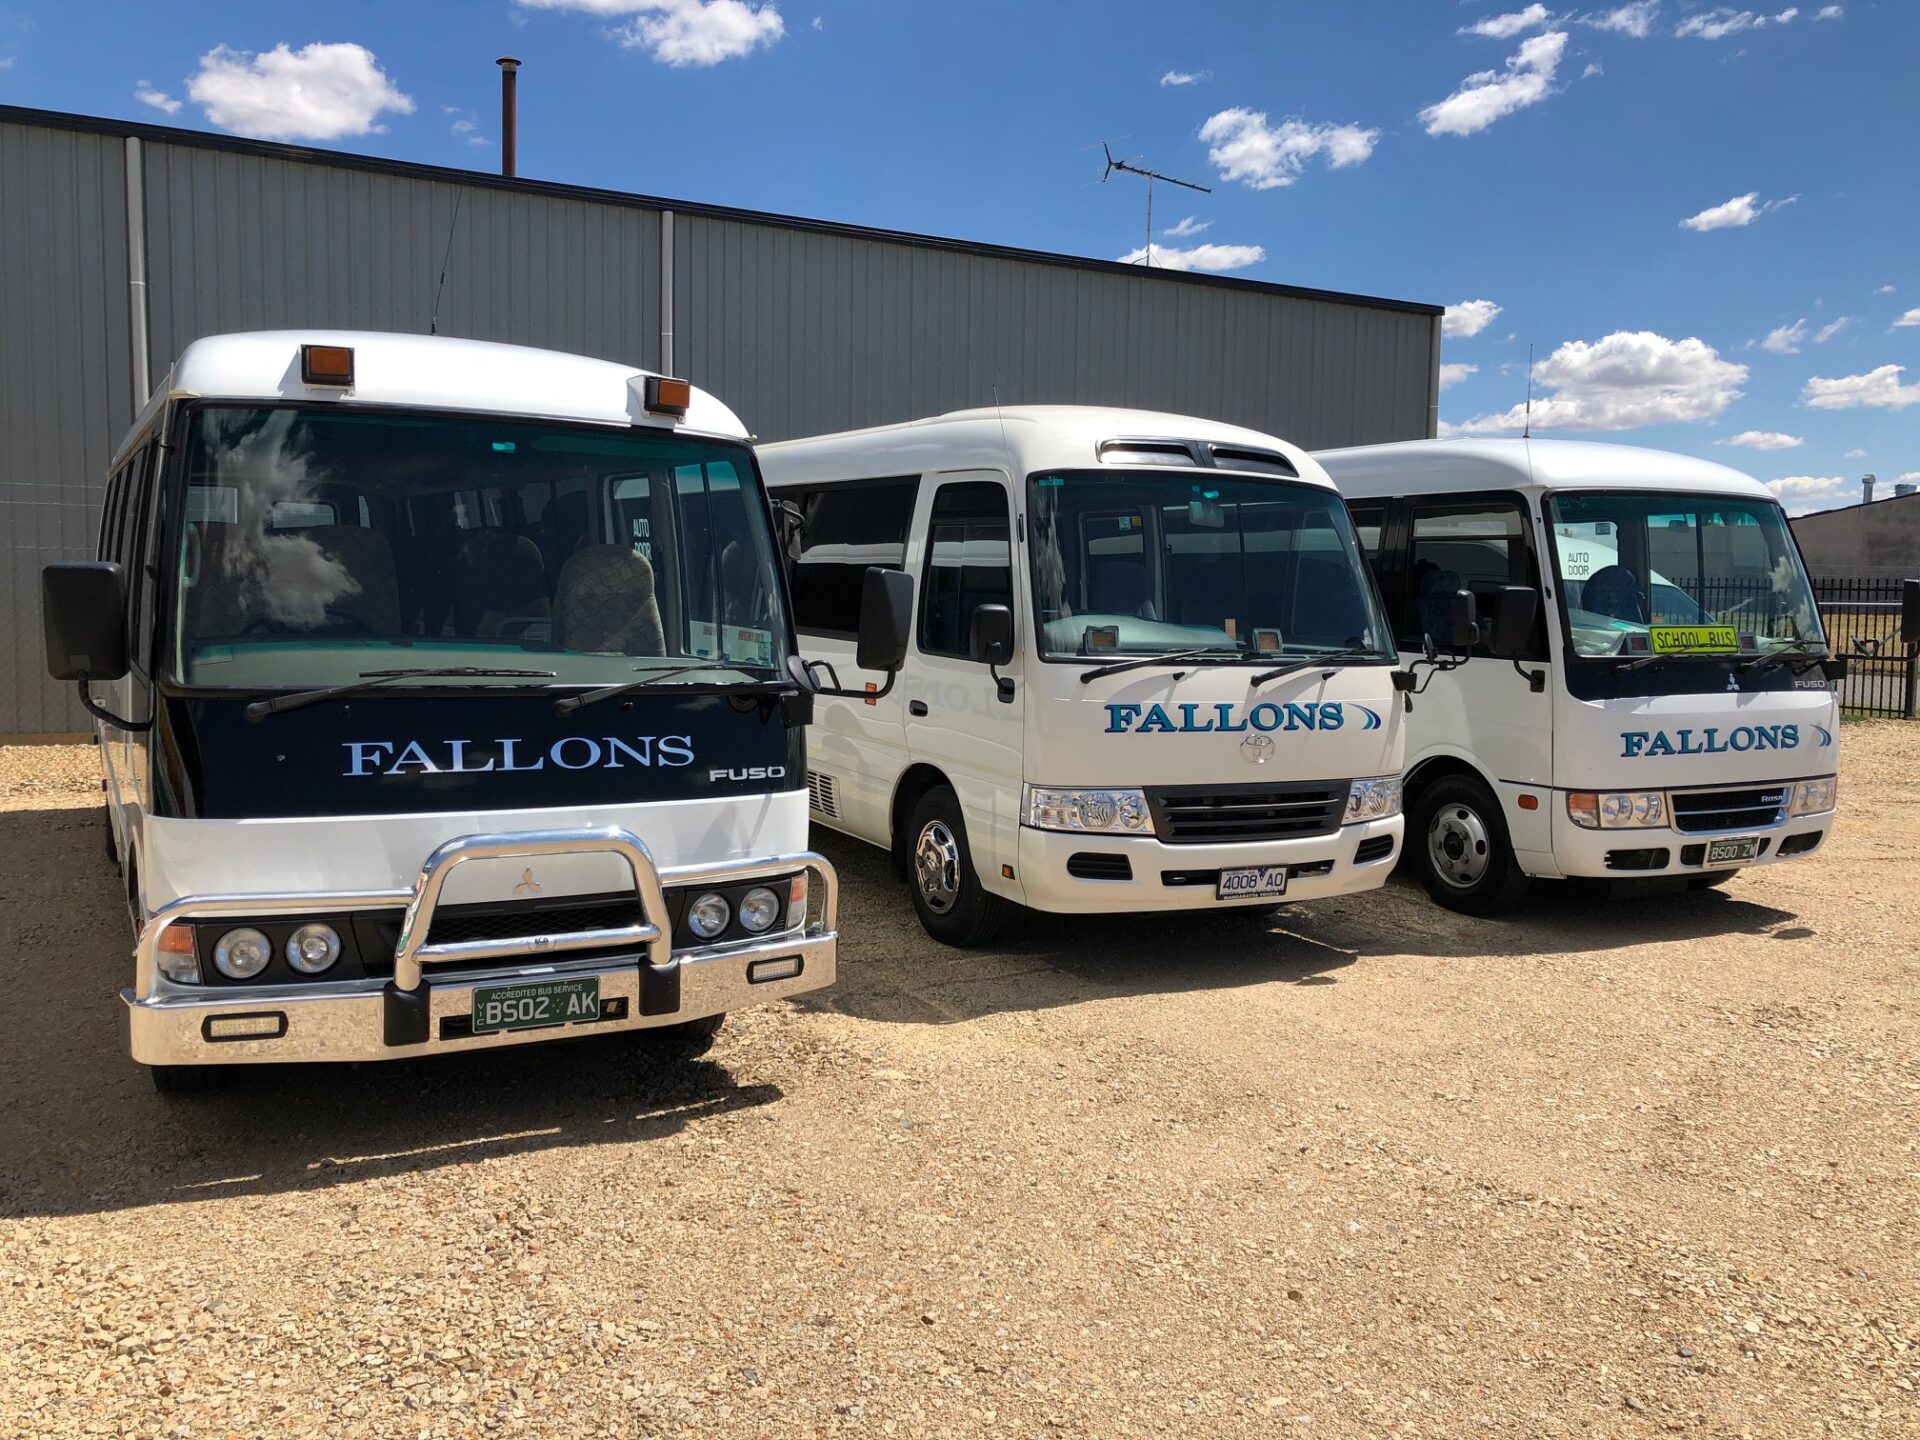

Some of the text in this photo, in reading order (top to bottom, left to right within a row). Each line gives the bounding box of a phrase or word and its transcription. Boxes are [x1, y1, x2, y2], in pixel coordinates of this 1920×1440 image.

[633, 518, 650, 537] AUTO
[1568, 552, 1590, 563] AUTO
[1568, 565, 1590, 576] DOOR
[1657, 631, 1734, 649] SCHOOL BUS
[1794, 679, 1825, 688] FUSO
[1104, 703, 1344, 733] FALLONS
[1621, 724, 1800, 758] FALLONS
[342, 735, 695, 777] FALLONS
[709, 766, 786, 782] FUSO
[1223, 875, 1258, 890] 4008
[491, 984, 583, 1000] ACCREDITED BUS SERVICE
[486, 991, 596, 1025] BS02 AK
